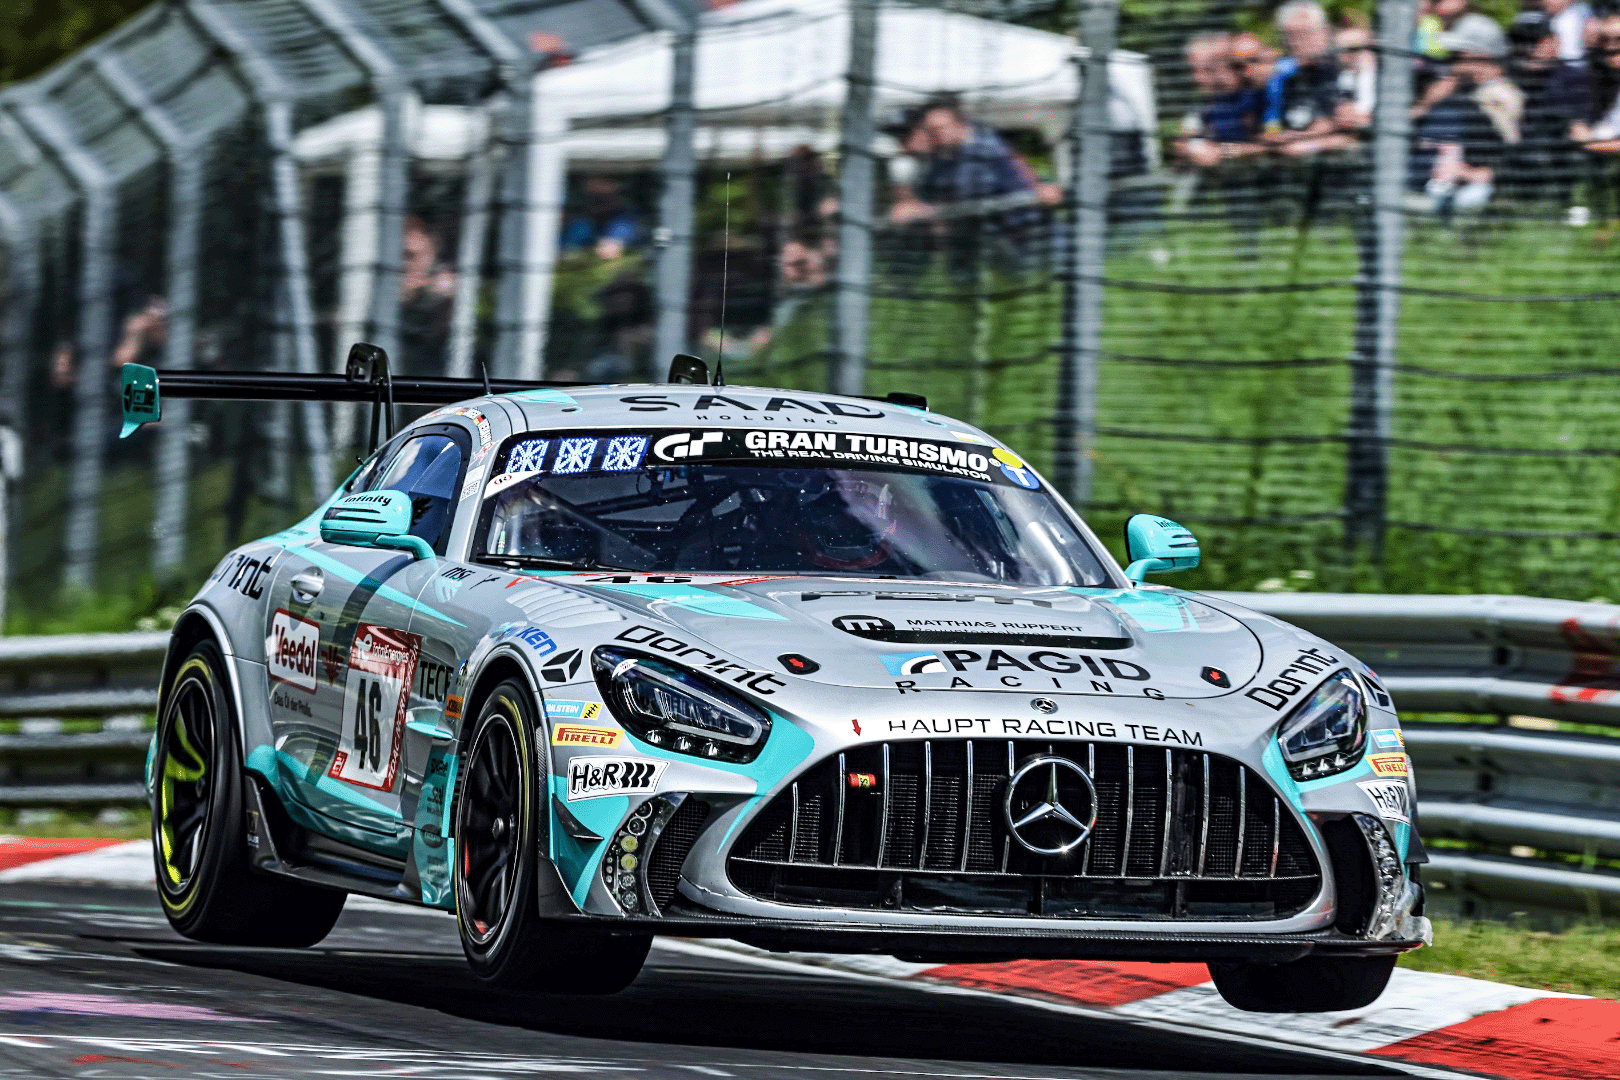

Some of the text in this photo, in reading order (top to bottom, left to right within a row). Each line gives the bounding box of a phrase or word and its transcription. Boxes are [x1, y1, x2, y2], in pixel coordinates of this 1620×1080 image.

[619, 394, 885, 419] SAAD
[696, 415, 838, 425] HOLDING
[744, 430, 836, 451] GRAN
[750, 449, 992, 482] THE REAL DRIVING SIMULATOR
[585, 576, 693, 584] 46
[906, 619, 996, 628] MATTHIAS
[1002, 622, 1082, 632] RUPPERT
[275, 624, 316, 677] Veedol
[614, 625, 787, 695] Dorint
[942, 649, 1151, 681] PAGID
[894, 676, 1165, 701] RACING
[1244, 648, 1340, 711] Dorint
[545, 704, 580, 714] BILSTEIN
[354, 678, 382, 773] 46
[557, 727, 618, 745] PIRELLI
[888, 718, 1203, 747] HAUPT RACING TEAM
[571, 761, 621, 792] H&R
